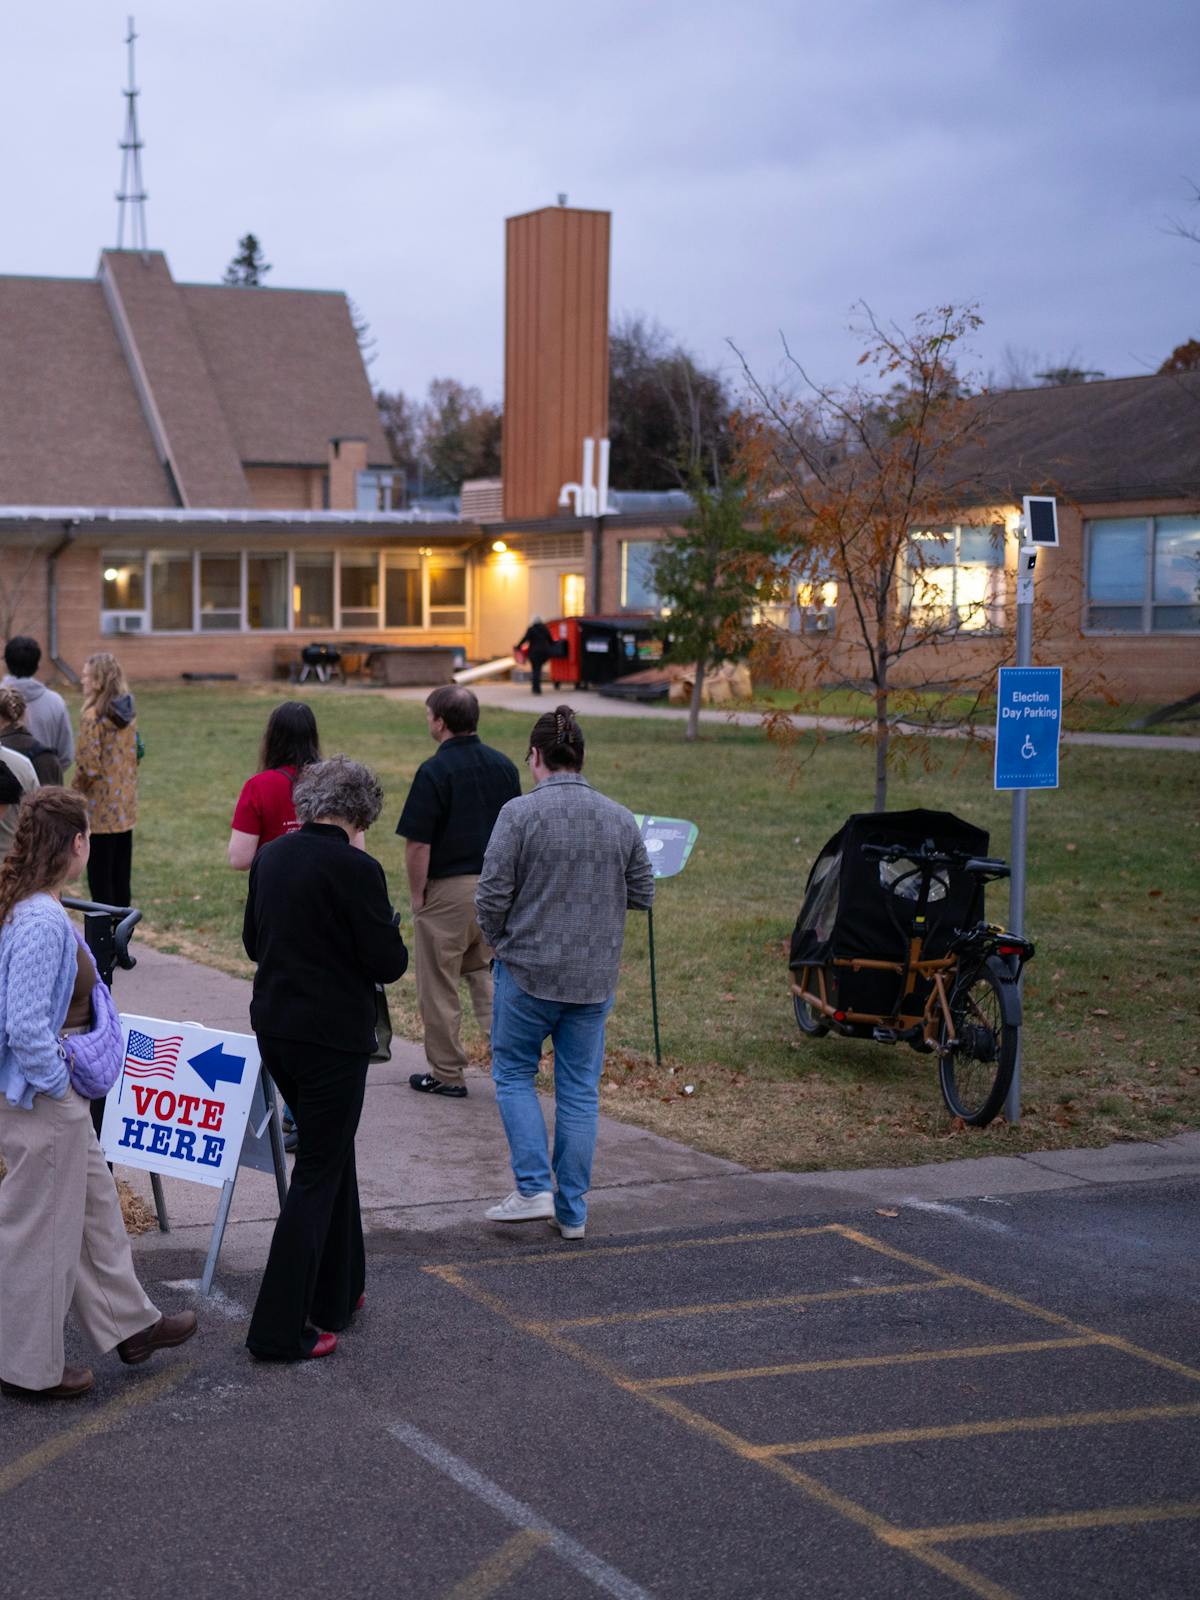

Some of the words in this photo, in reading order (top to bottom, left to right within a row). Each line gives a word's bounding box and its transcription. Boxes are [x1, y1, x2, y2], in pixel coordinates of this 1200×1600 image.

[1012, 691, 1049, 702] Election
[1002, 707, 1021, 720] Day
[1024, 707, 1057, 720] Parking
[131, 1085, 225, 1132] VOTE
[118, 1117, 225, 1168] HERE
